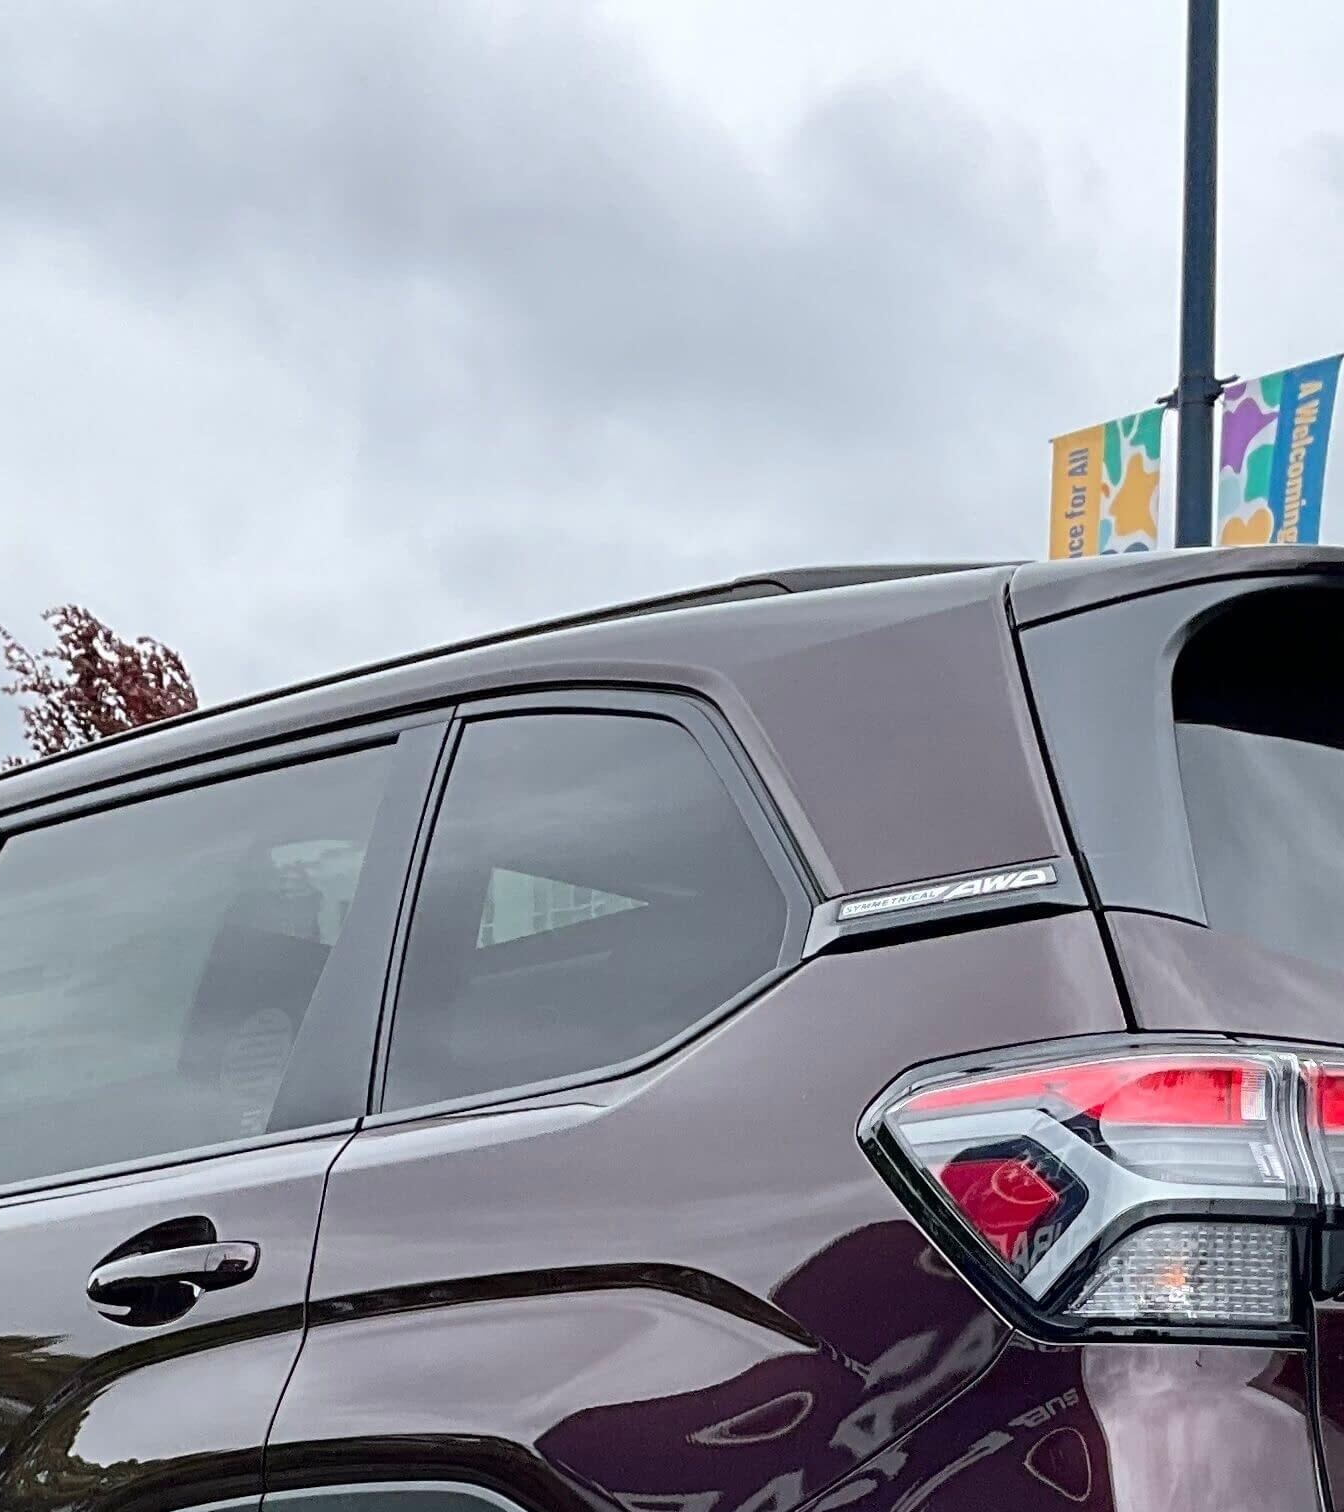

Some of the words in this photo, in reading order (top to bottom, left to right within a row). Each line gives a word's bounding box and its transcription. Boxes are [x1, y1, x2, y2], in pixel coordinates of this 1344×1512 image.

[1298, 381, 1323, 400] A
[1068, 448, 1088, 476] All
[1277, 400, 1320, 543] Welcoming
[1065, 485, 1087, 518] for
[844, 889, 937, 915] SYMMETRICAL
[943, 869, 1047, 901] AWD
